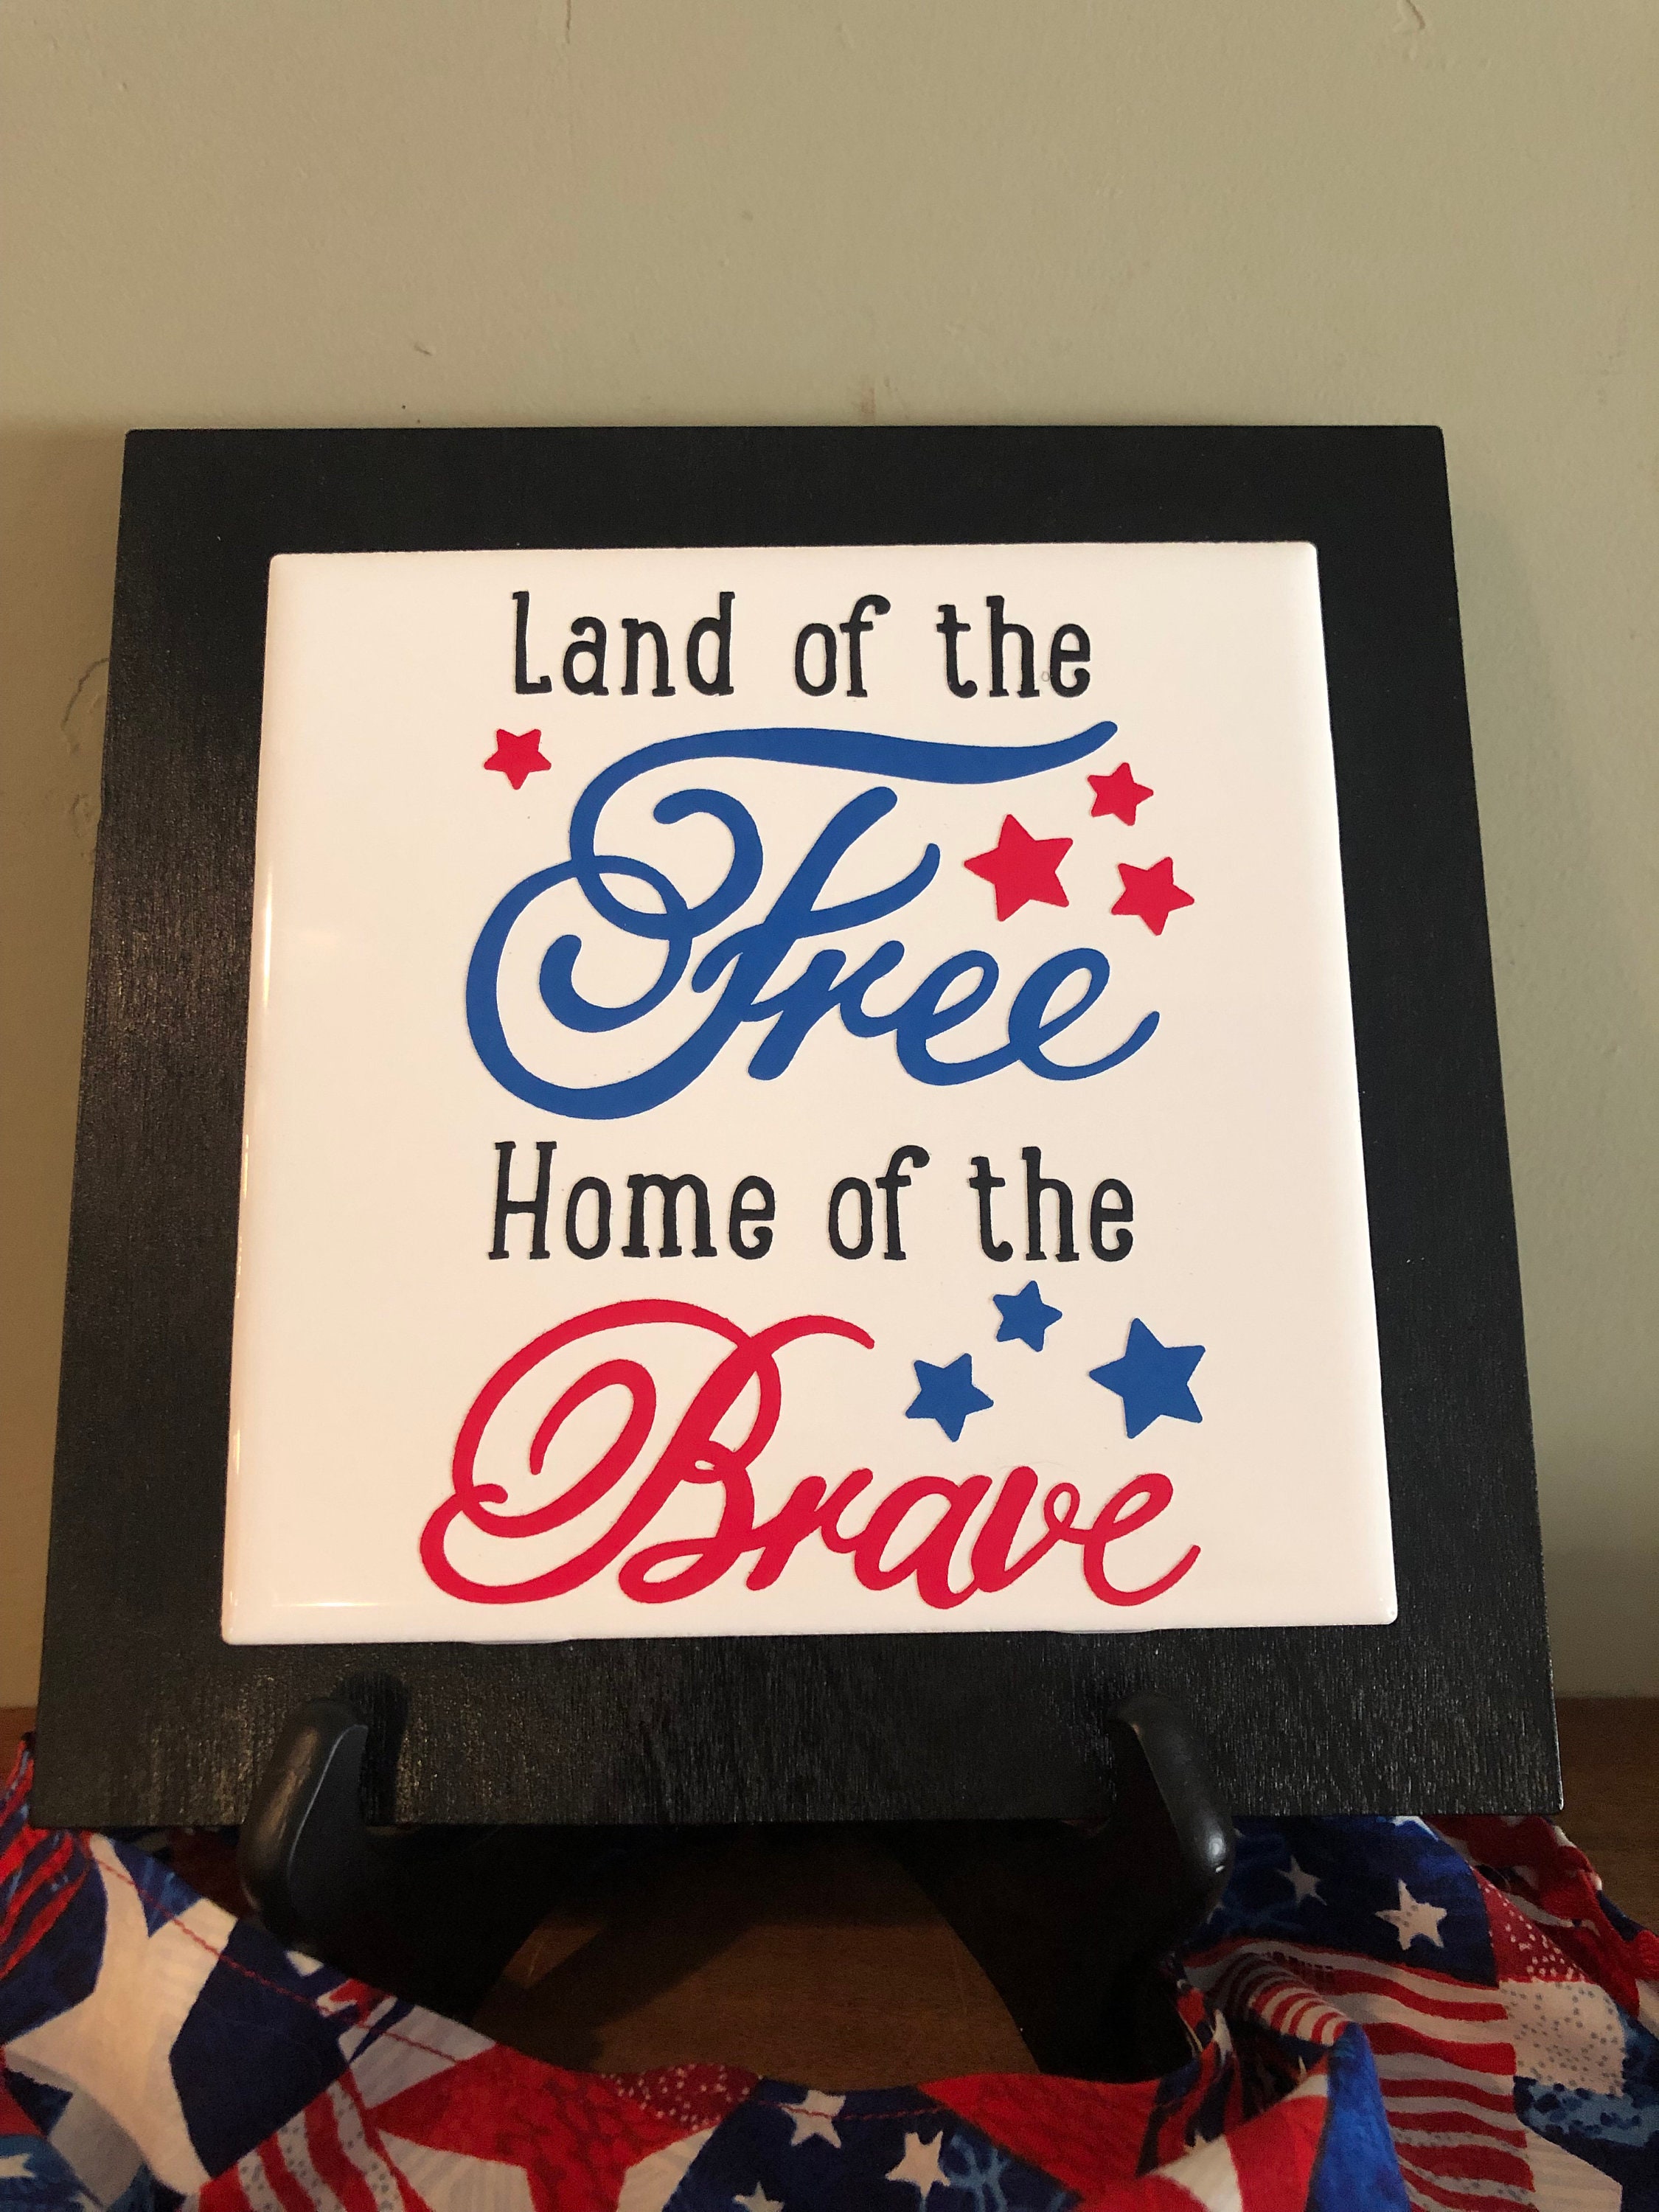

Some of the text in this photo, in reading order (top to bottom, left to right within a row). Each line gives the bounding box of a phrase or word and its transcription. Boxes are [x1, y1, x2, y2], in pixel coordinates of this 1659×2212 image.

[512, 591, 1091, 698] Land of the
[466, 722, 1160, 1119] Free
[489, 1141, 1134, 1262] Home of the
[420, 1299, 1201, 1610] Brave
